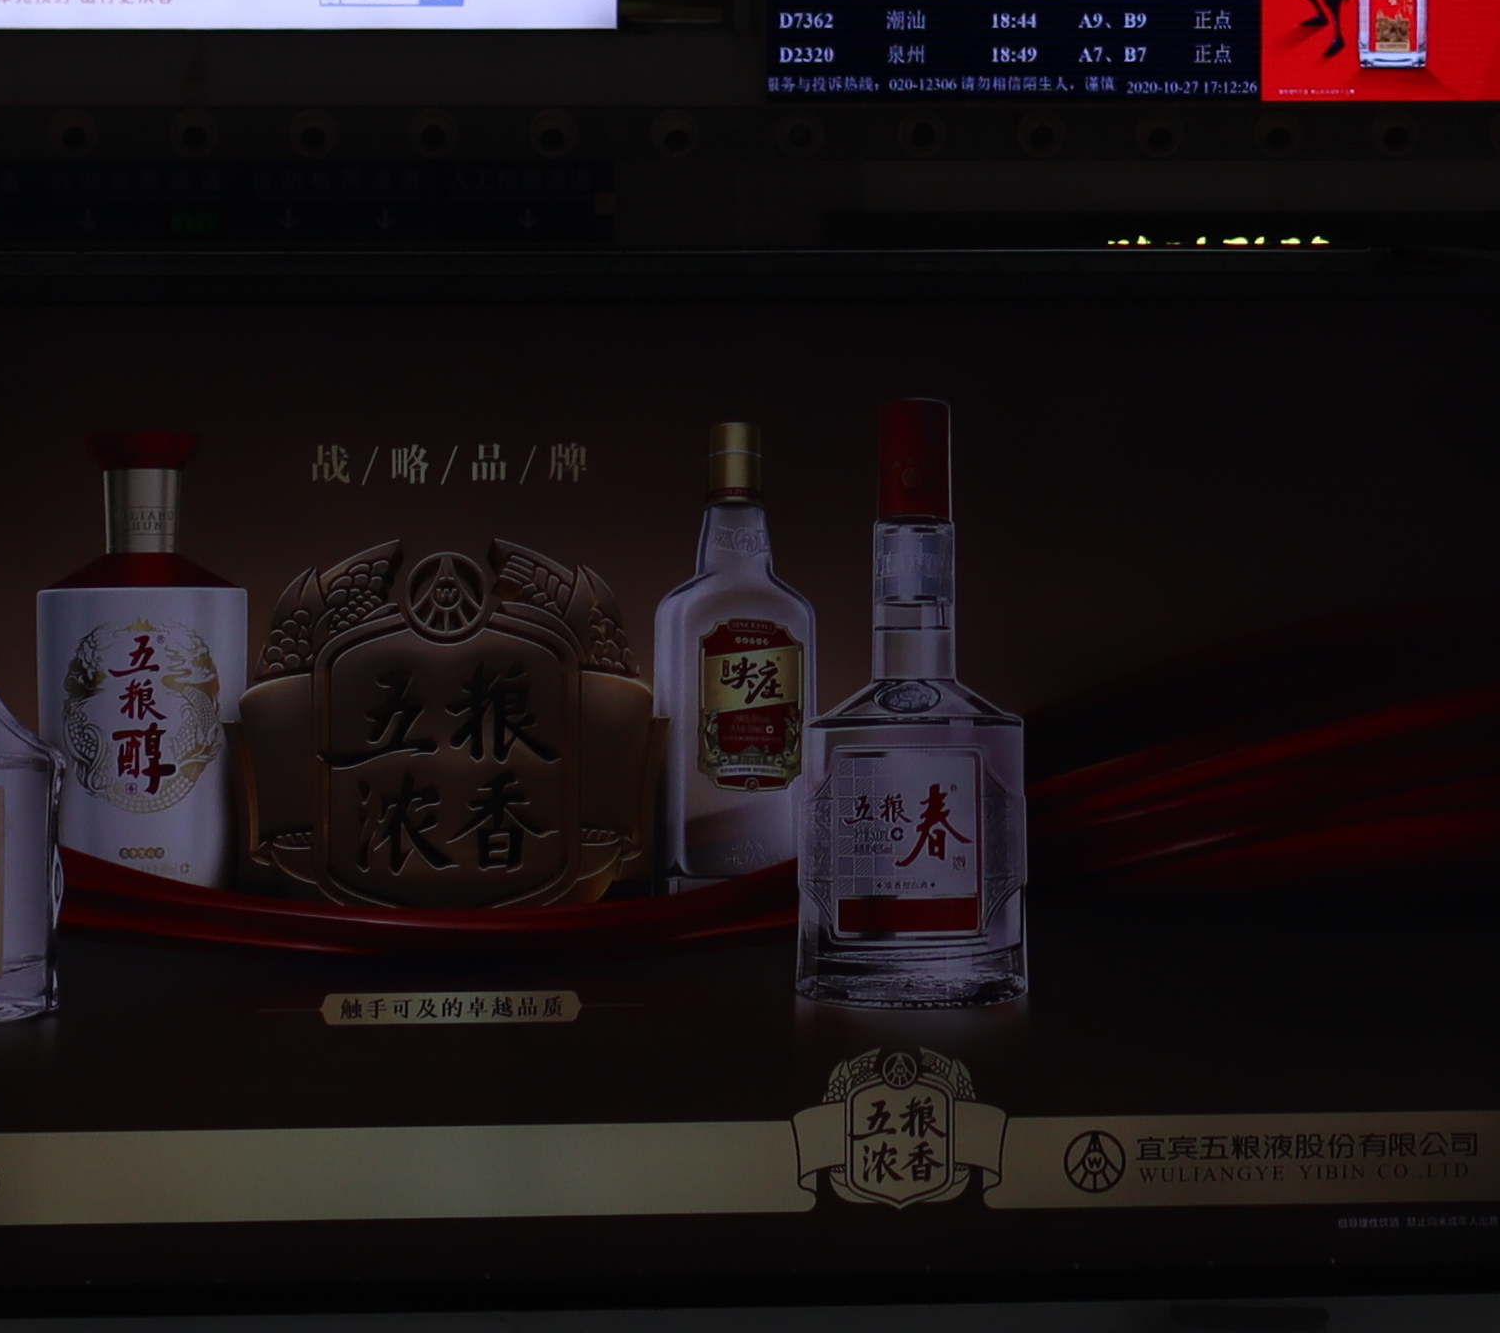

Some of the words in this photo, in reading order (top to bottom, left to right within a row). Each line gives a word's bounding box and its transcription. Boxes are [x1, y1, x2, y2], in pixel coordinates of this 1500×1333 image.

[778, 11, 835, 30] D7362
[885, 10, 927, 31] 潮汕
[990, 11, 1039, 30] 18:44
[1193, 10, 1234, 31] 正点
[778, 45, 835, 64] D2320
[885, 44, 927, 65] 泉州
[990, 45, 1039, 64] 18:49
[1193, 44, 1234, 65] 正点
[1126, 79, 1200, 95] 2020-10-27
[1203, 79, 1258, 95] 17:12:26
[720, 656, 785, 705] 尖庄
[108, 634, 176, 795] 五粮醇
[316, 662, 562, 770] 五粮
[357, 772, 561, 876] 浓香
[844, 783, 974, 867] 五粮春
[340, 995, 565, 1021] 触手可及的卓越品质
[849, 1096, 948, 1141] 五粮
[862, 1141, 944, 1186] 浓香
[1135, 1132, 1480, 1163] 宜宾五粮液股份有限公司
[1139, 1165, 1285, 1183] WULIANGYE
[1300, 1164, 1366, 1181] YIBIN
[1337, 1217, 1400, 1230] 倡导理性饮酒
[1405, 1215, 1500, 1229] 禁止向未成年人出售
